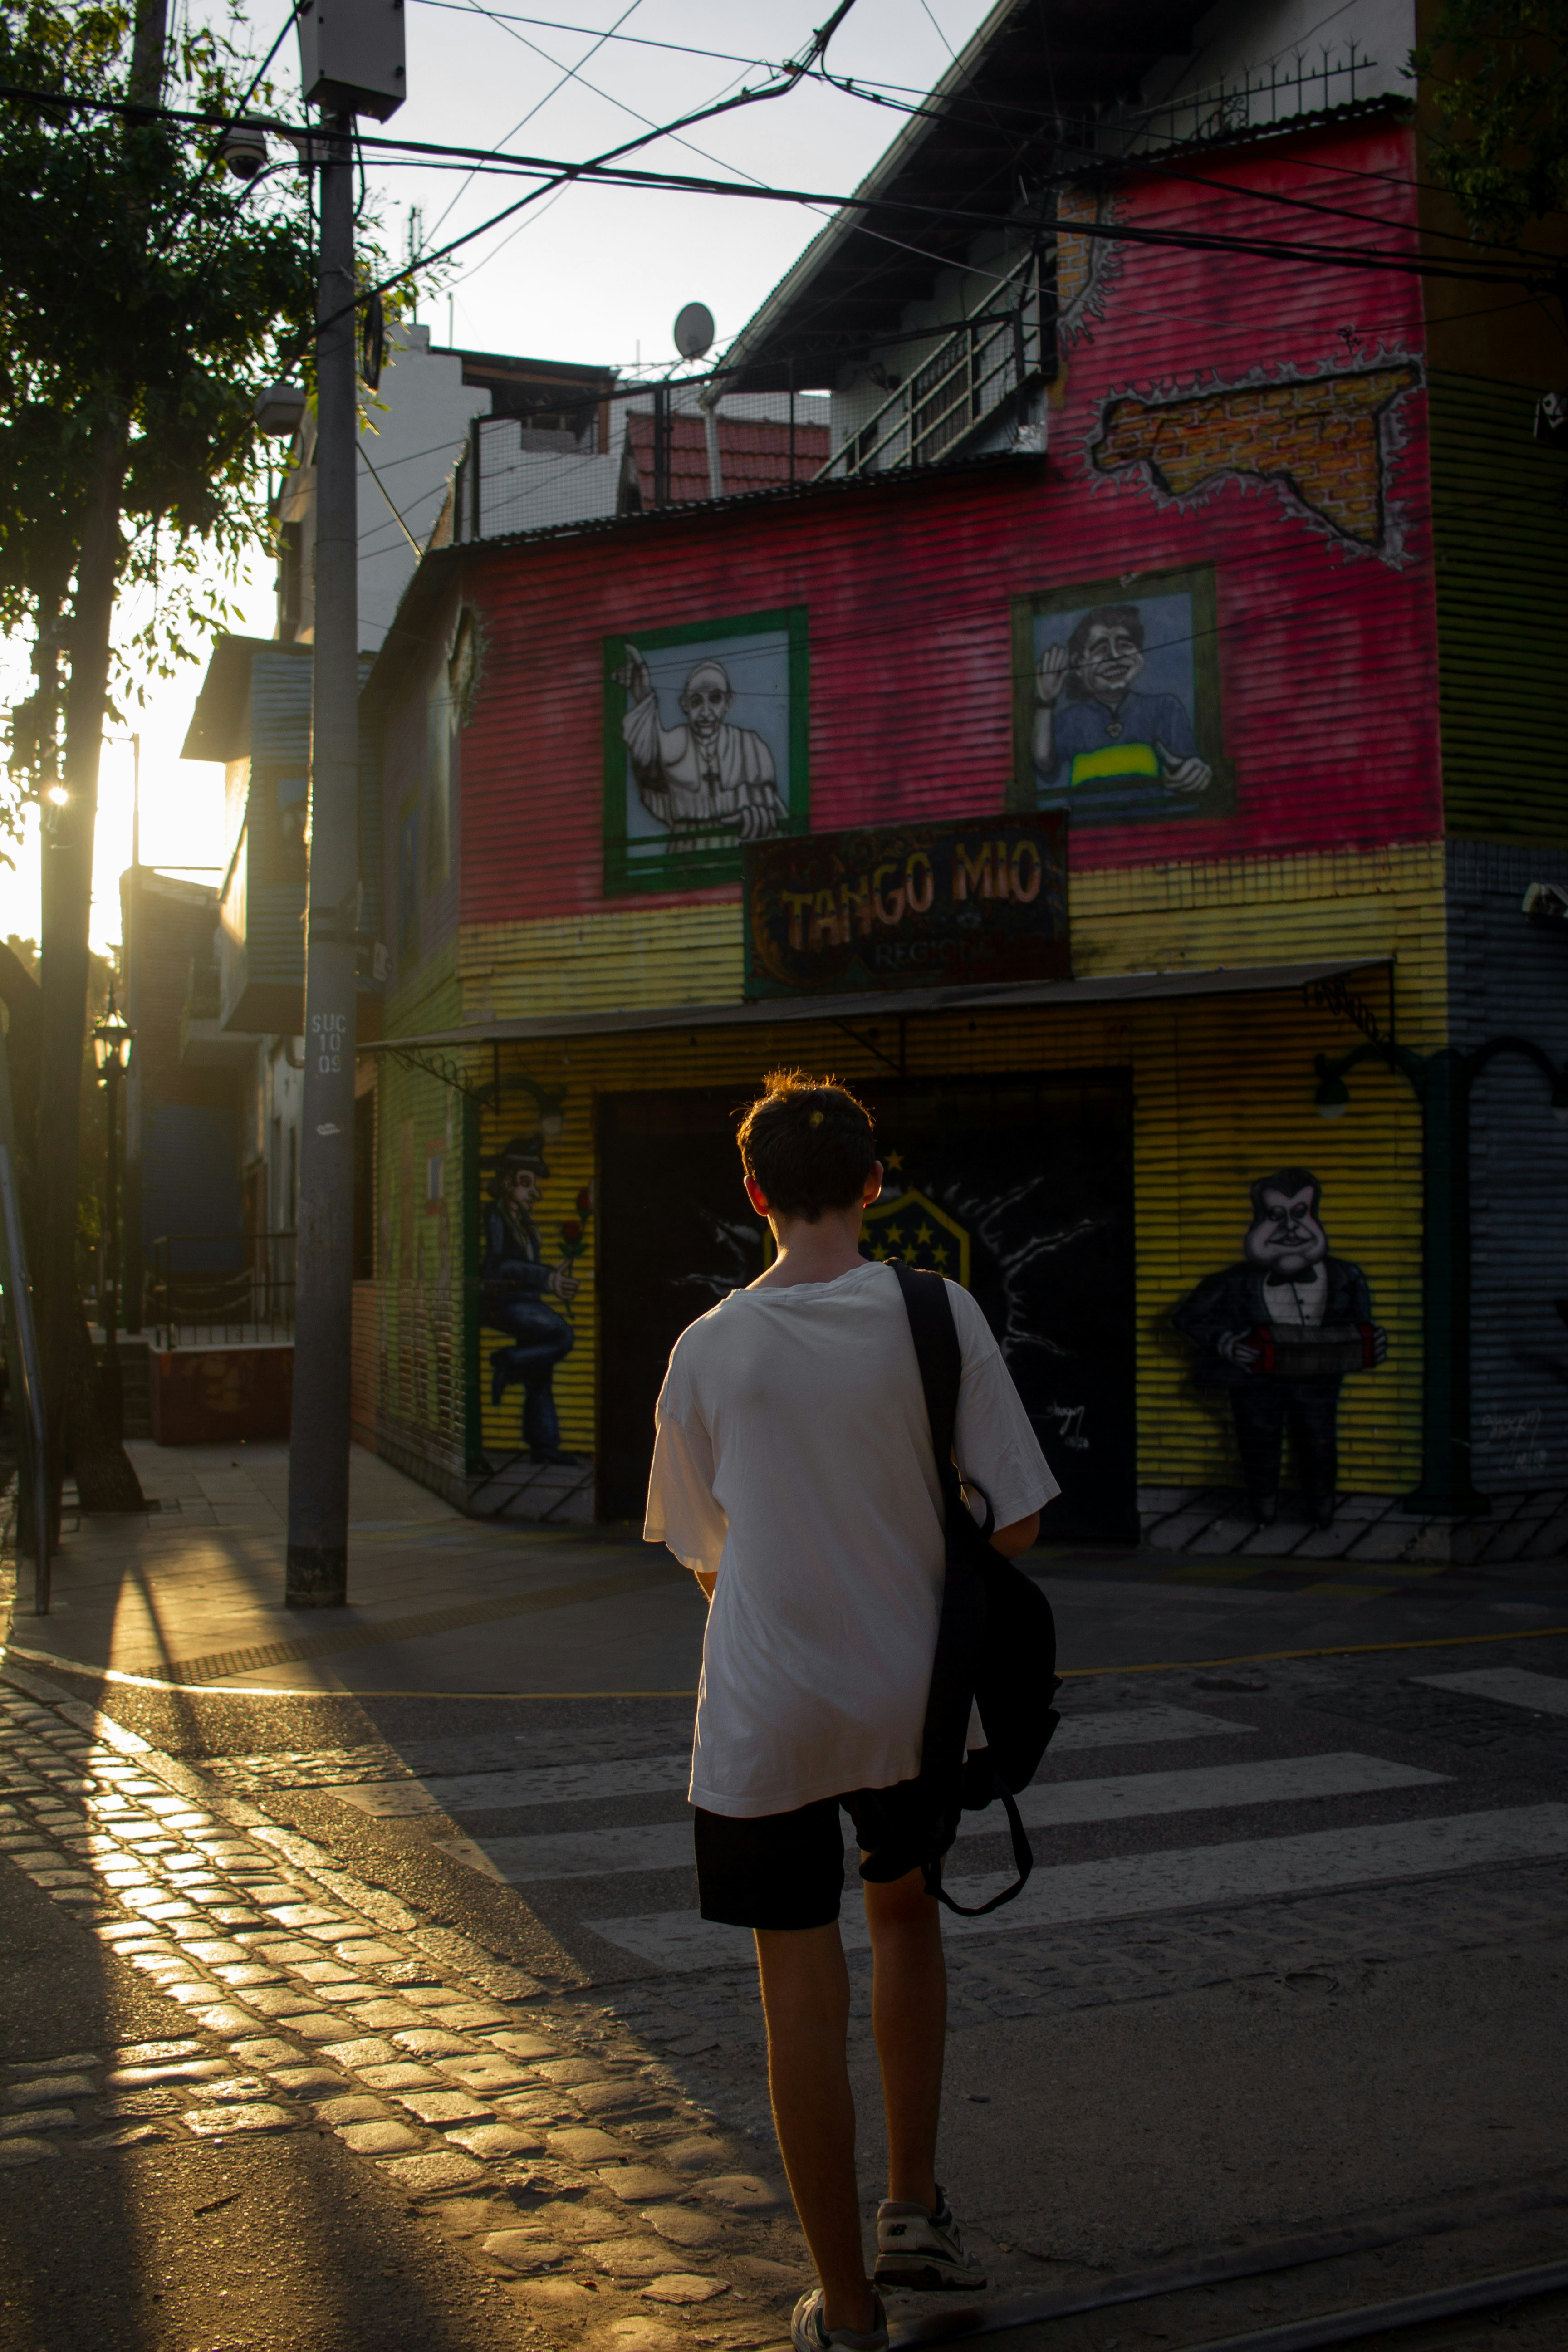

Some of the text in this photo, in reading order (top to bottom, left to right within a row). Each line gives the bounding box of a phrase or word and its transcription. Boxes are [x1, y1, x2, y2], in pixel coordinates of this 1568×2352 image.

[781, 838, 1042, 951] TANGO MIO
[312, 1013, 346, 1033] SUC
[320, 1033, 341, 1052] 10
